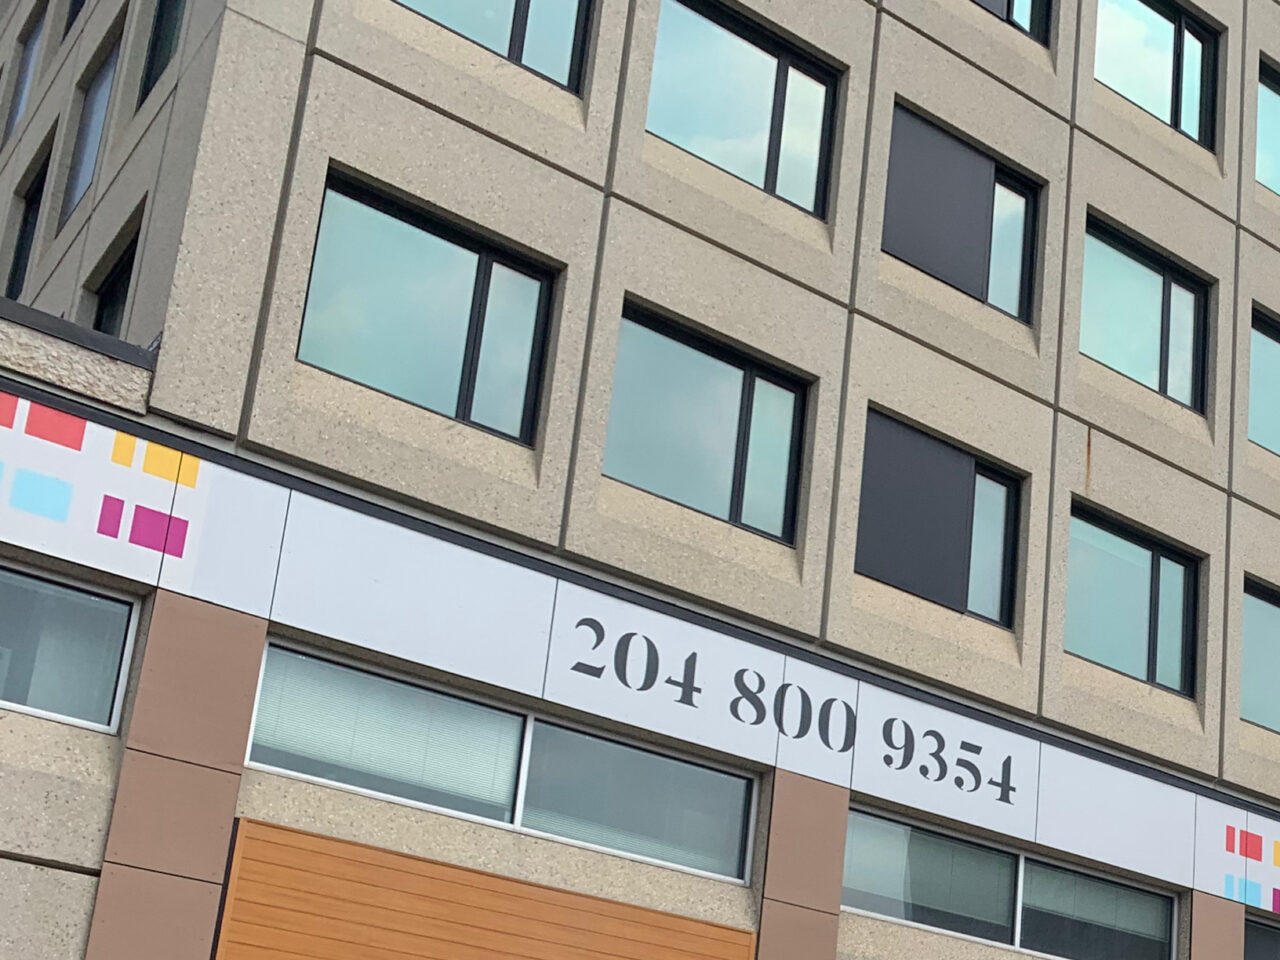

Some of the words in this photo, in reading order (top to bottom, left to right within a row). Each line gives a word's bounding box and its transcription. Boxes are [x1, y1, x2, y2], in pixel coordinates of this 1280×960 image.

[570, 617, 702, 708] 204
[729, 667, 857, 753] 800
[882, 717, 1017, 805] 9354
